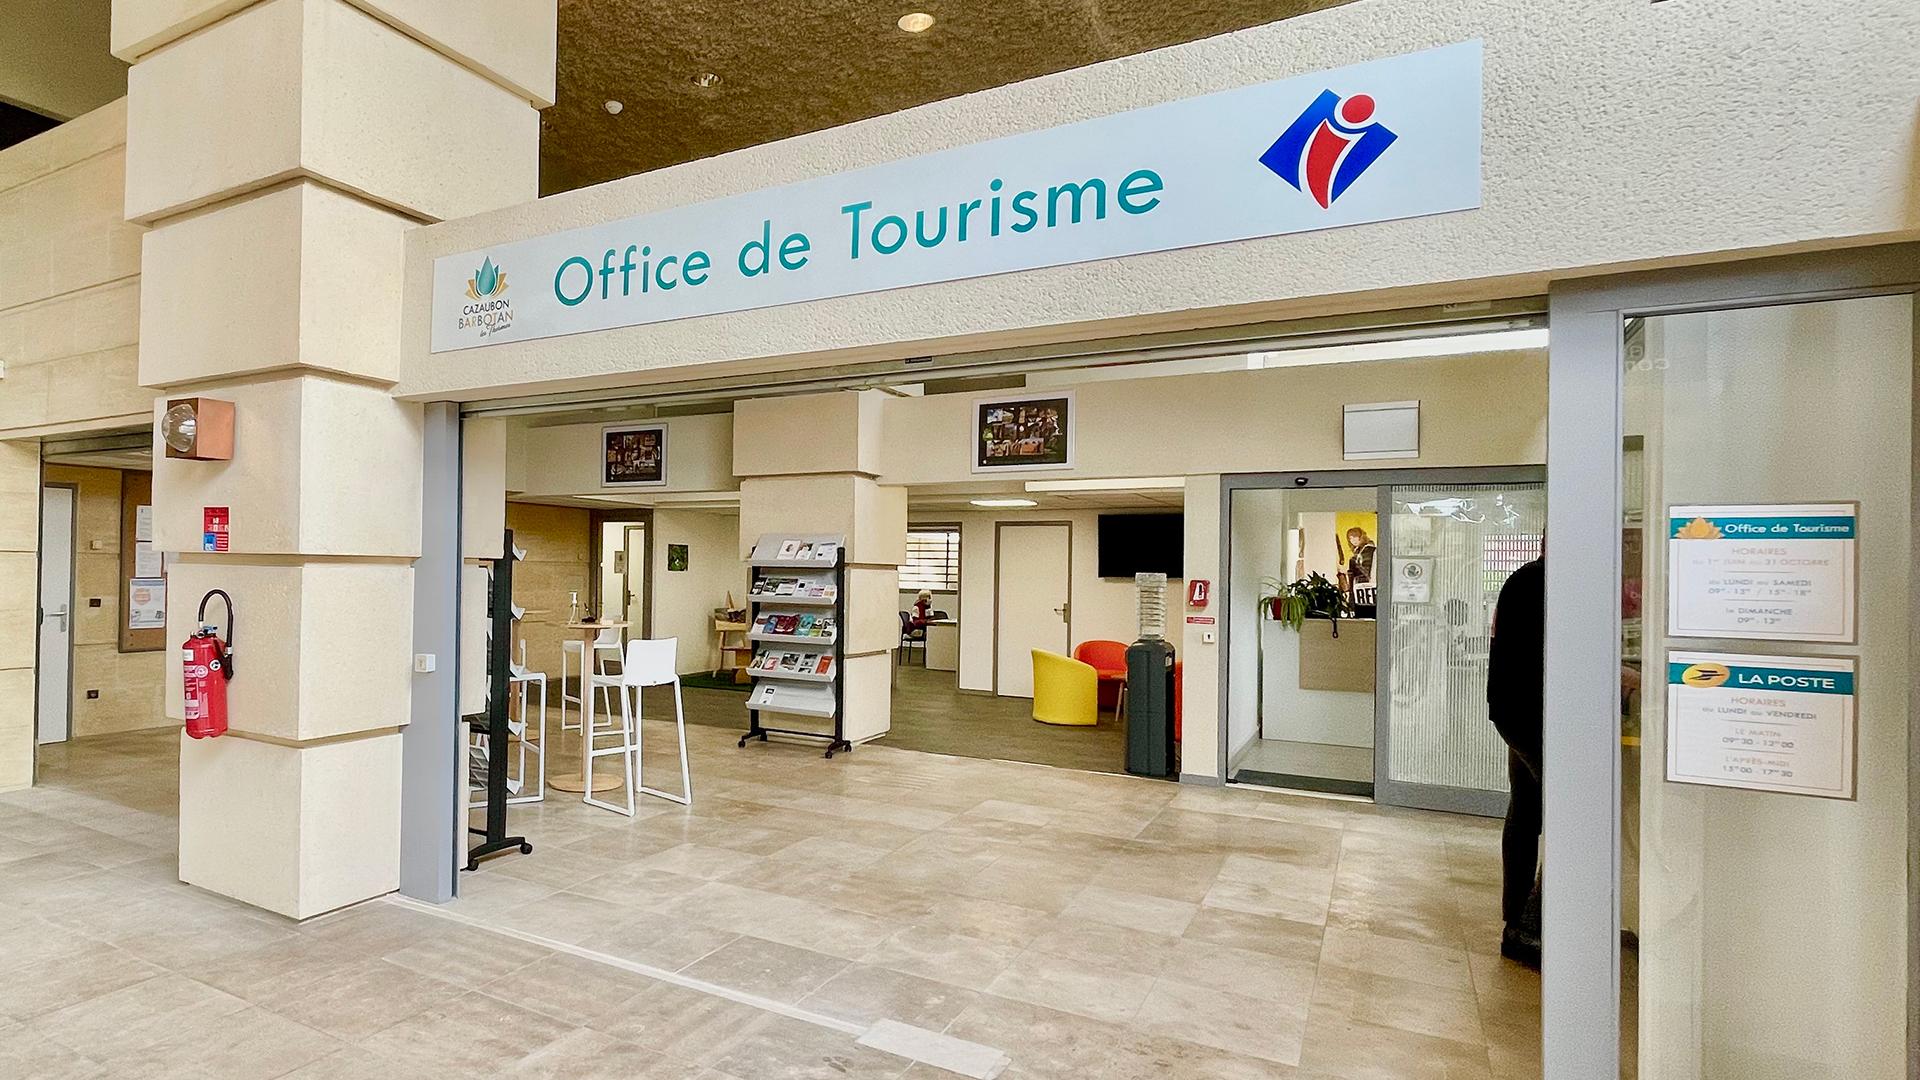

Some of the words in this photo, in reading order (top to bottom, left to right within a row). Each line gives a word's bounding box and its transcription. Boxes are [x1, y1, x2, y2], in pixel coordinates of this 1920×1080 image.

[553, 244, 711, 307] Office
[738, 219, 811, 277] de
[841, 169, 1164, 260] Tourisme
[463, 299, 510, 315] CAZAUBON
[458, 310, 514, 329] BARBOTAN
[1725, 523, 1766, 533] Office
[1771, 523, 1789, 533] de
[1793, 523, 1850, 533] Tourisme
[1732, 548, 1787, 556] HORAIRES
[1773, 579, 1812, 587] SAMEDI
[1738, 607, 1793, 616] DIMANCHE
[1738, 673, 1764, 685] LA
[1767, 675, 1835, 689] POSTE
[1731, 696, 1787, 708] HORAIRES
[1718, 706, 1748, 715] LUNDI
[1766, 711, 1818, 720] VENDREDI
